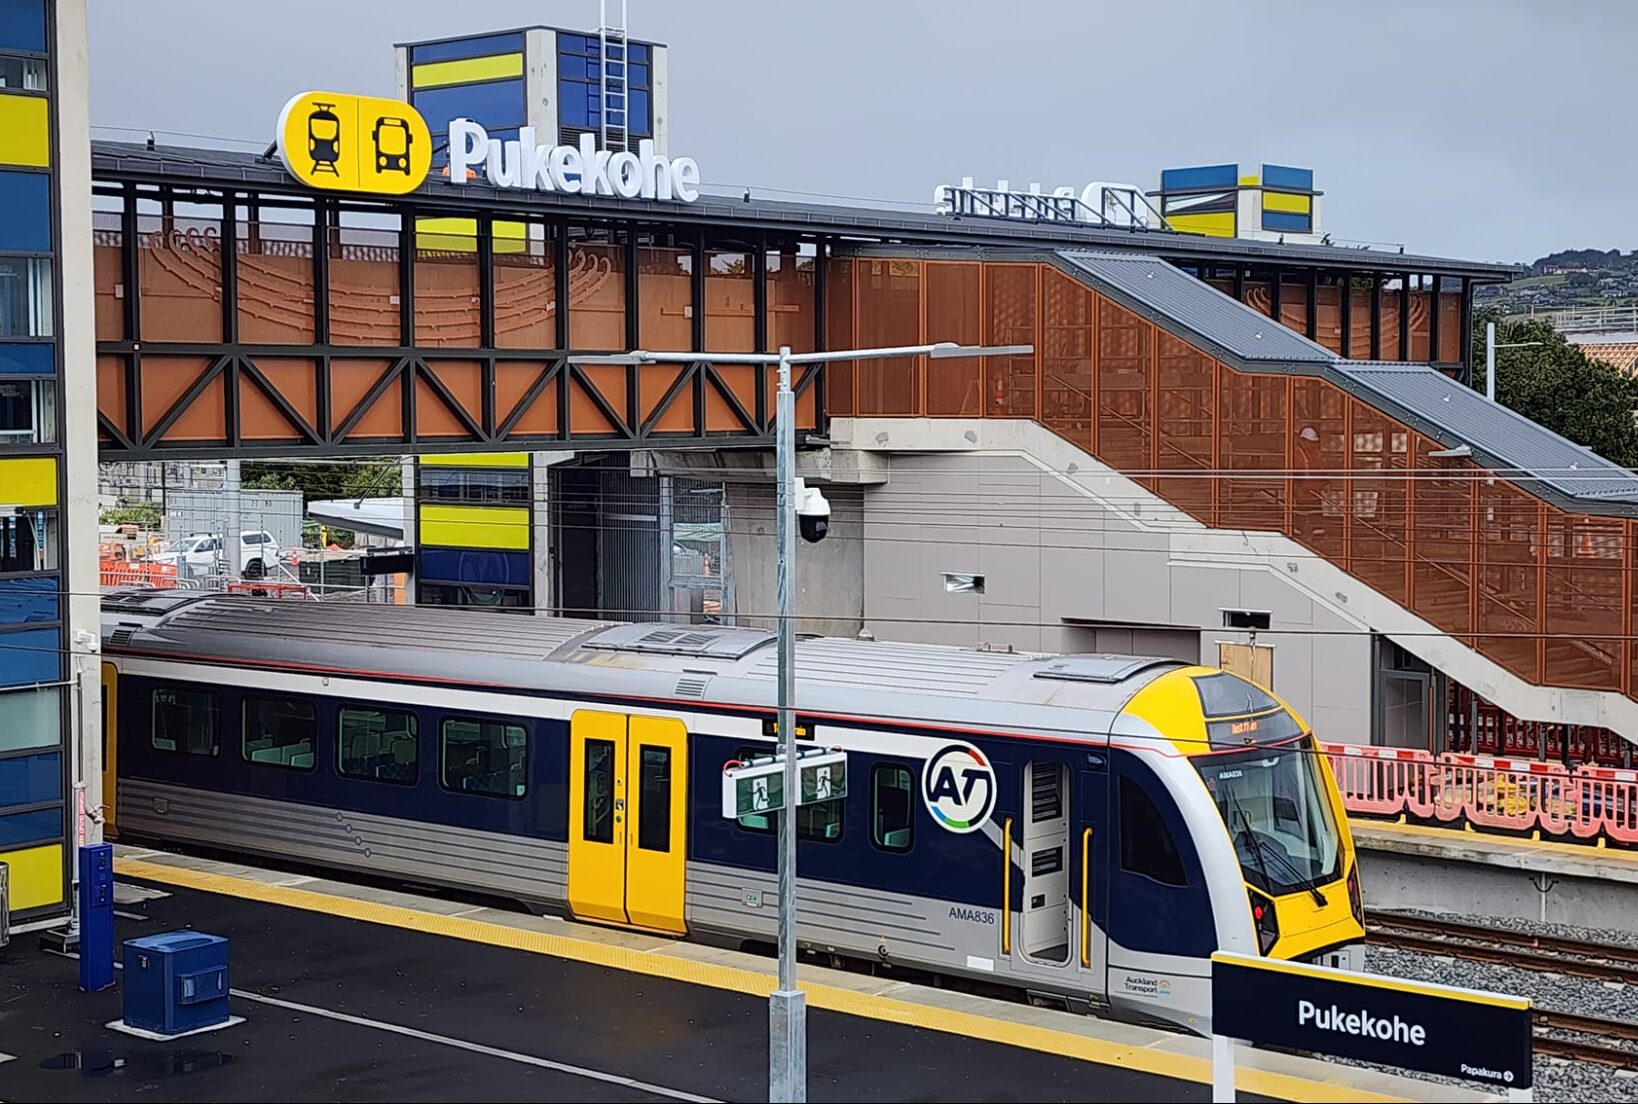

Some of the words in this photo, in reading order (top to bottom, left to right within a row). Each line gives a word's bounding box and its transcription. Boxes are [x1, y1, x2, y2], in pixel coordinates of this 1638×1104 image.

[449, 118, 700, 203] Pukekohe
[928, 766, 990, 806] AT
[949, 907, 995, 925] AMA836
[1124, 982, 1158, 994] Transport
[1126, 976, 1158, 987] Auckland
[1298, 999, 1427, 1046] Pukekohe
[1460, 1063, 1503, 1081] Papakura
